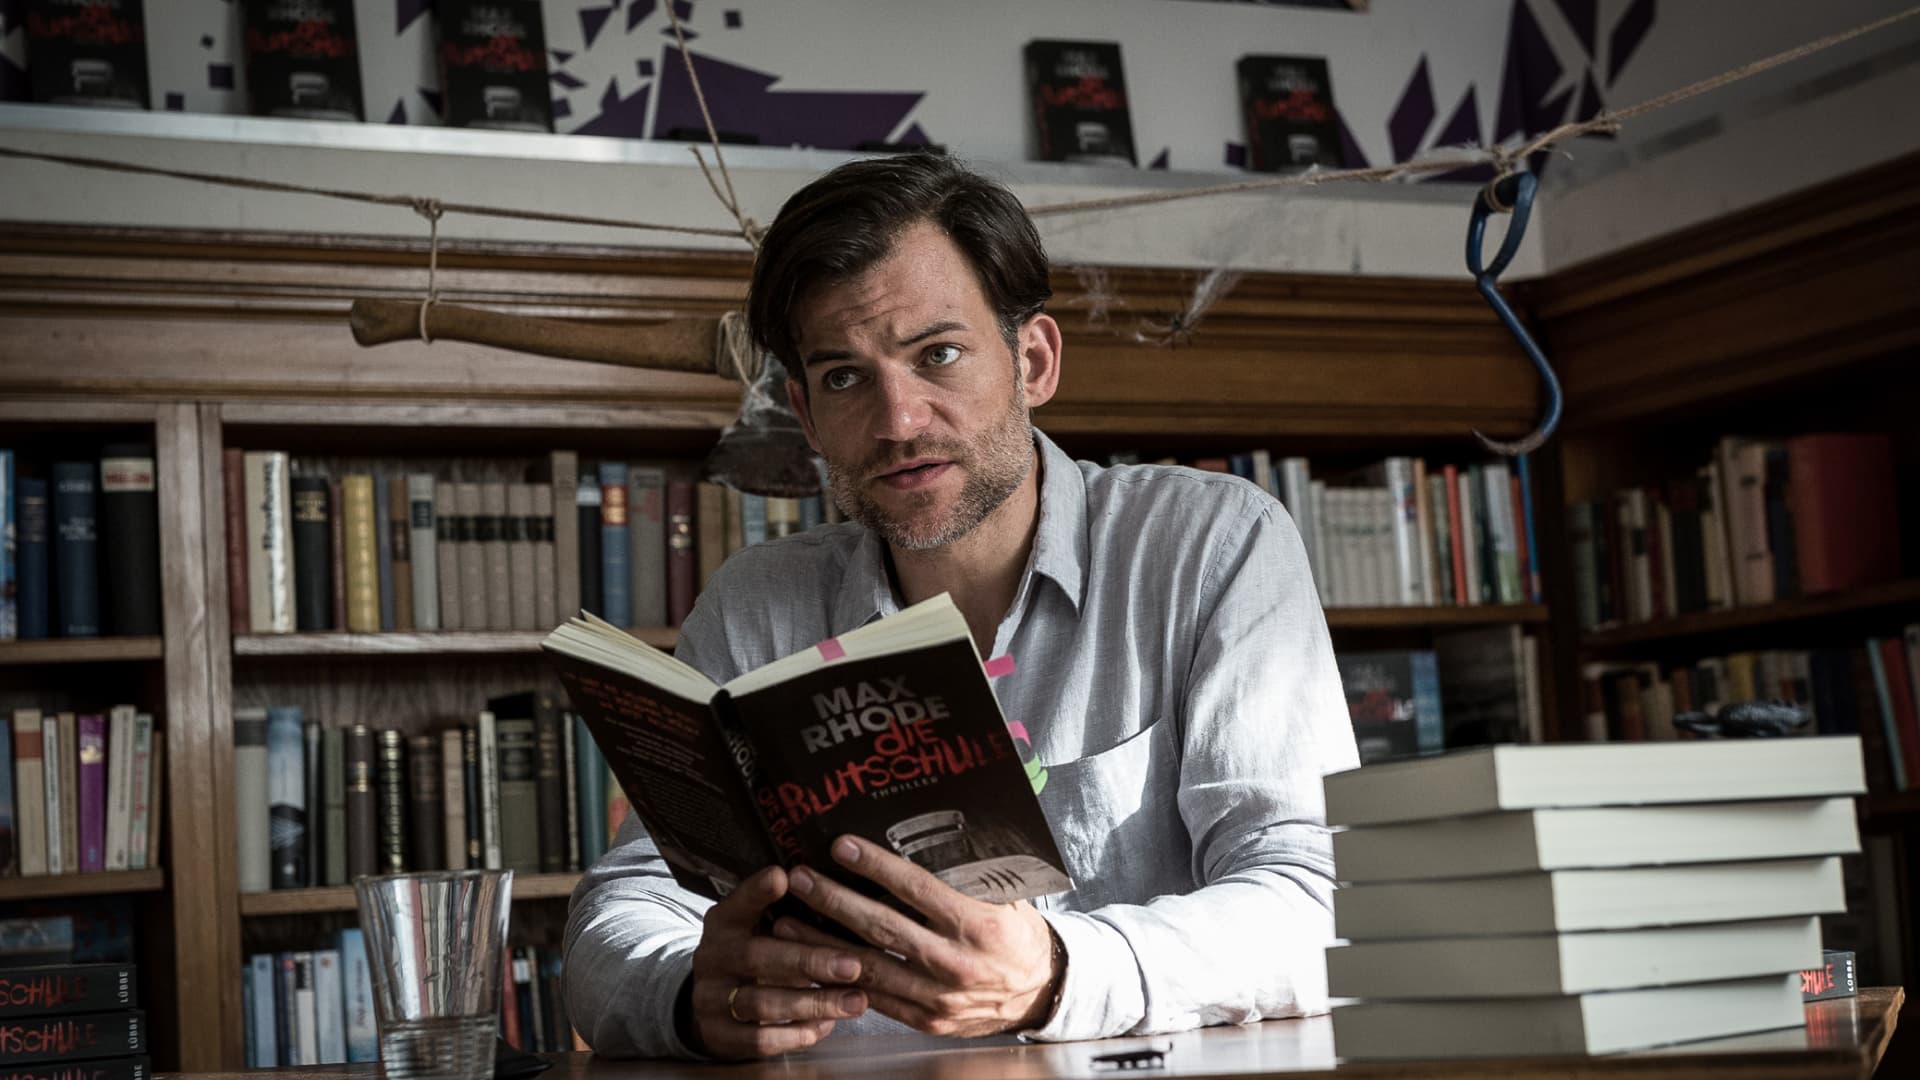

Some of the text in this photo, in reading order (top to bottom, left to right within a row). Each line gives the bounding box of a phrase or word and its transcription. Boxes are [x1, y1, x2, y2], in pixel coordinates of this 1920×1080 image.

[811, 674, 917, 720] MAX
[799, 696, 950, 754] RHODE
[117, 971, 130, 1004] LÜBBE
[127, 1017, 139, 1049] LÜBBE
